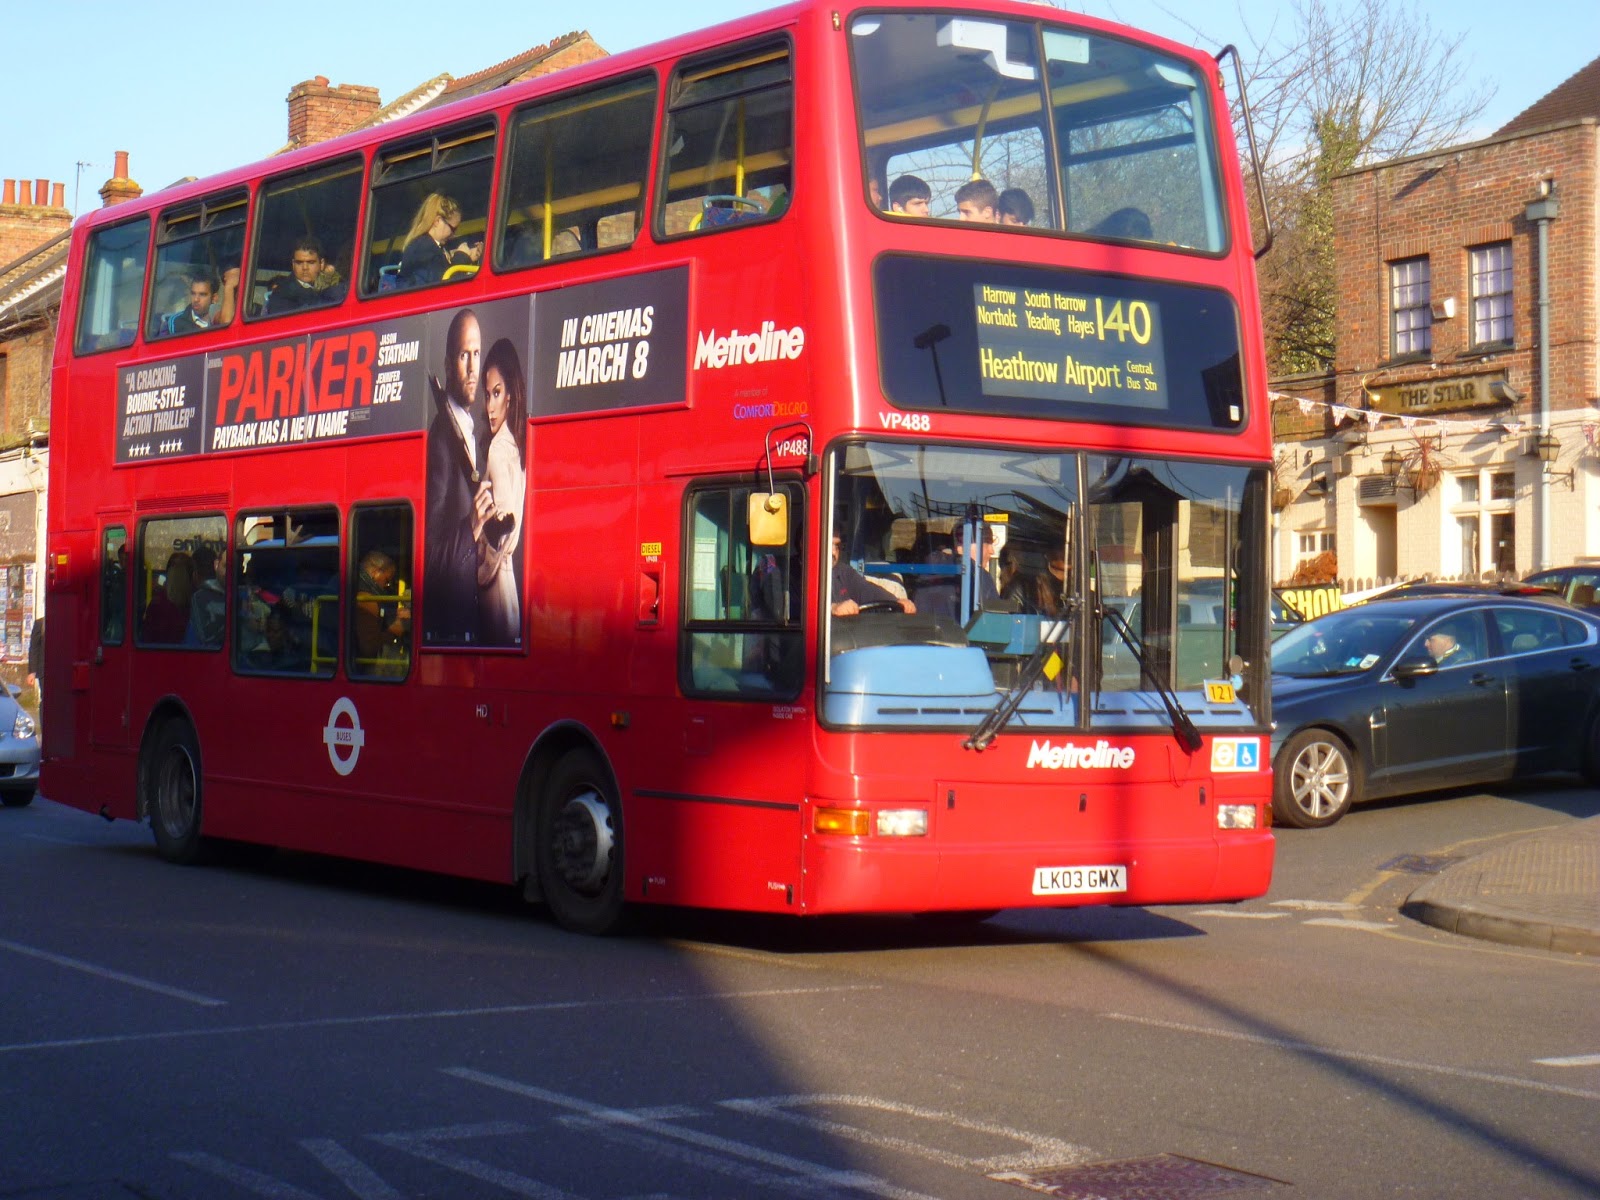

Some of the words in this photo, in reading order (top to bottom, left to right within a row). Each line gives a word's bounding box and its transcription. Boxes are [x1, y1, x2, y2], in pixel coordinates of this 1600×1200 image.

[983, 286, 1016, 305] Harrow
[1024, 290, 1052, 309] South
[1054, 293, 1087, 312] Harrow
[561, 318, 579, 348] IN
[580, 306, 655, 344] CINEMAS
[977, 305, 1018, 328] Northolt
[1025, 310, 1061, 336] Yeading
[1068, 314, 1095, 339] Hayes
[1095, 297, 1152, 345] 140
[380, 333, 397, 346] JASON
[693, 321, 804, 370] Metroline
[378, 341, 420, 367] STATHAM
[556, 342, 629, 388] MARCH
[632, 341, 650, 379] 8
[136, 364, 177, 391] CRACKING
[215, 330, 377, 426] PARKER
[376, 370, 401, 385] JENNIFER
[980, 347, 1058, 384] Heathrow
[1065, 355, 1122, 394] Airport
[1126, 360, 1154, 375] Central
[373, 381, 404, 405] LOPEZ
[1126, 376, 1141, 390] Bus
[1398, 390, 1429, 408] THE
[1433, 382, 1475, 403] STAR
[126, 386, 186, 415] BOURNE-STYLE
[123, 414, 153, 437] ACTION
[212, 422, 258, 450] PAYBACK
[258, 420, 280, 445] HAS
[279, 419, 289, 442] A
[289, 414, 316, 441] NEW
[315, 410, 350, 438] NAME
[879, 412, 931, 431] VP488
[775, 438, 808, 457] VP488
[642, 544, 661, 555] DIESEL
[1211, 686, 1233, 700] 121
[336, 731, 352, 742] BUSES
[1026, 740, 1136, 769] Metroline
[1039, 870, 1083, 889] LK03
[1088, 869, 1120, 888] GMX
